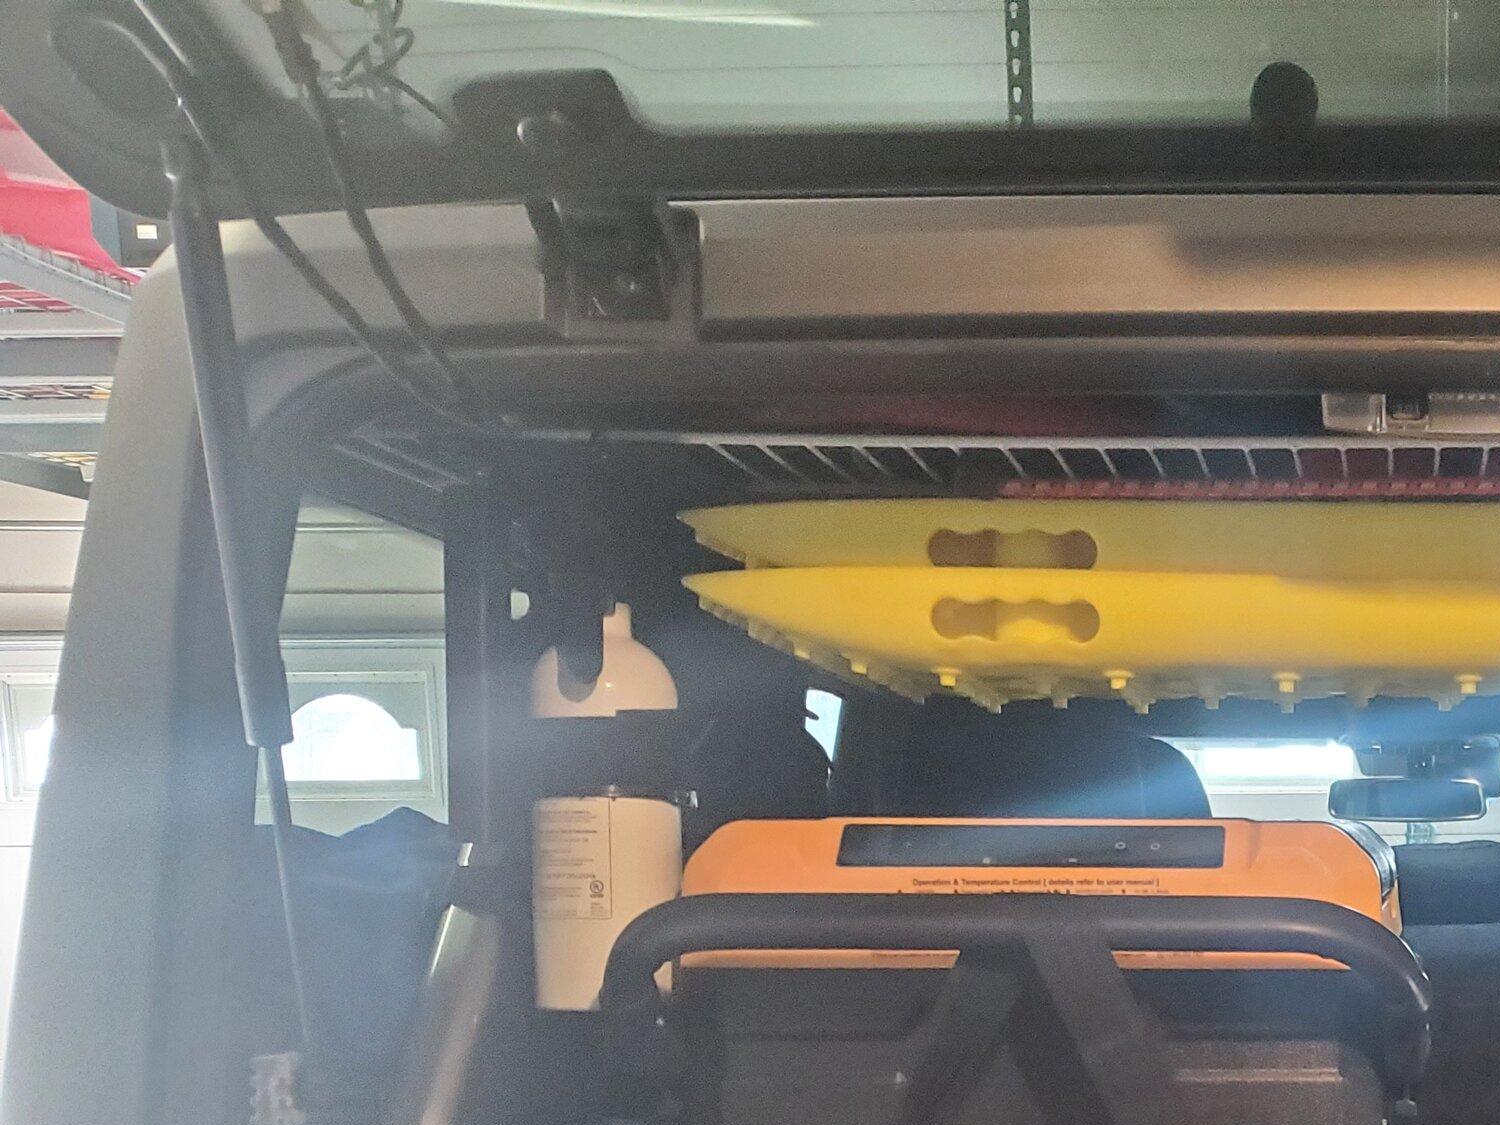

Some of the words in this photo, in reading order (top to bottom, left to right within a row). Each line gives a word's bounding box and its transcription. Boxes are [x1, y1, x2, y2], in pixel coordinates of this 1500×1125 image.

[912, 878, 951, 887] Operation
[961, 878, 1010, 887] Temperature
[1012, 878, 1041, 886] Control
[1048, 878, 1074, 886] details
[1076, 878, 1095, 886] refer
[1096, 878, 1105, 886] to
[1125, 878, 1155, 886] manual
